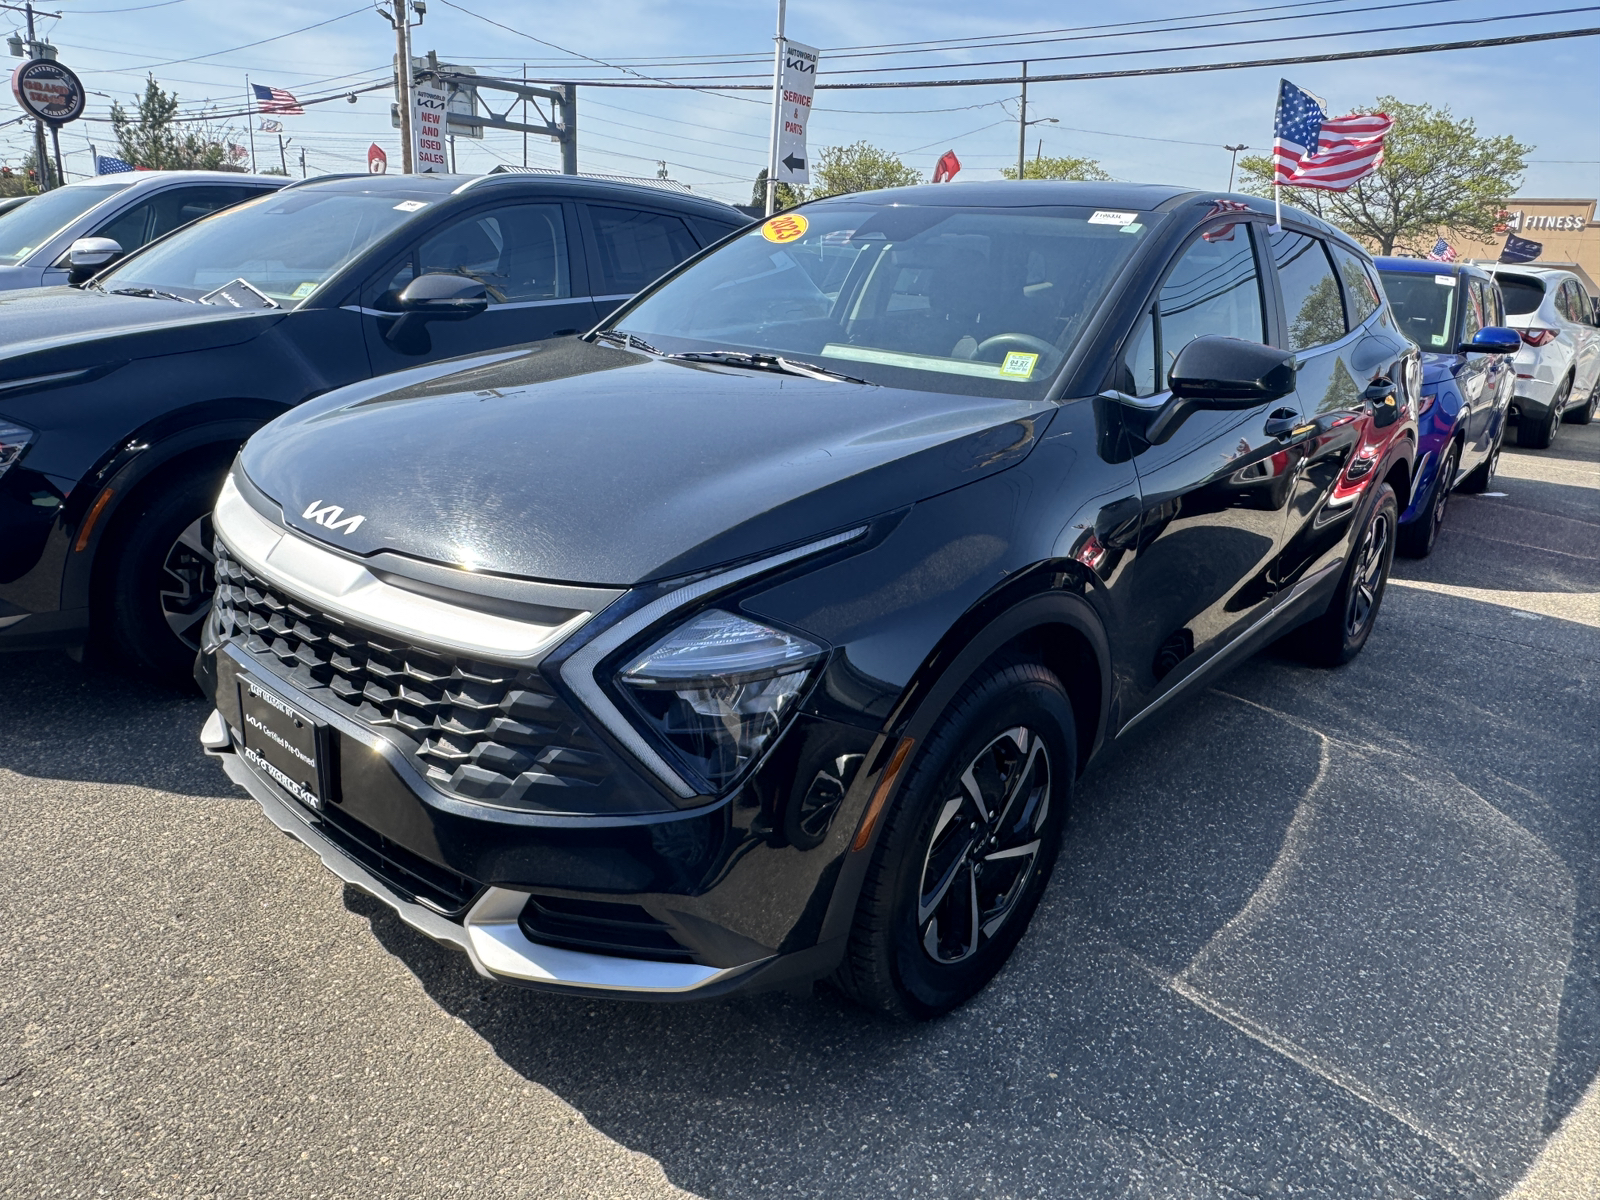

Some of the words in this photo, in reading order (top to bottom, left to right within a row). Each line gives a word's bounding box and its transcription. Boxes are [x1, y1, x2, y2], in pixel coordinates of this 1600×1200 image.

[787, 47, 816, 62] AUTOWORLD
[421, 111, 440, 124] NEW
[793, 108, 798, 119] &
[422, 126, 439, 137] AND
[785, 121, 803, 135] PARTS
[420, 138, 441, 151] USED
[418, 151, 444, 164] SALES
[1525, 215, 1583, 229] FITNESS
[302, 500, 365, 535] KIA
[262, 725, 284, 747] Certified
[284, 738, 316, 768] Pre-Owned
